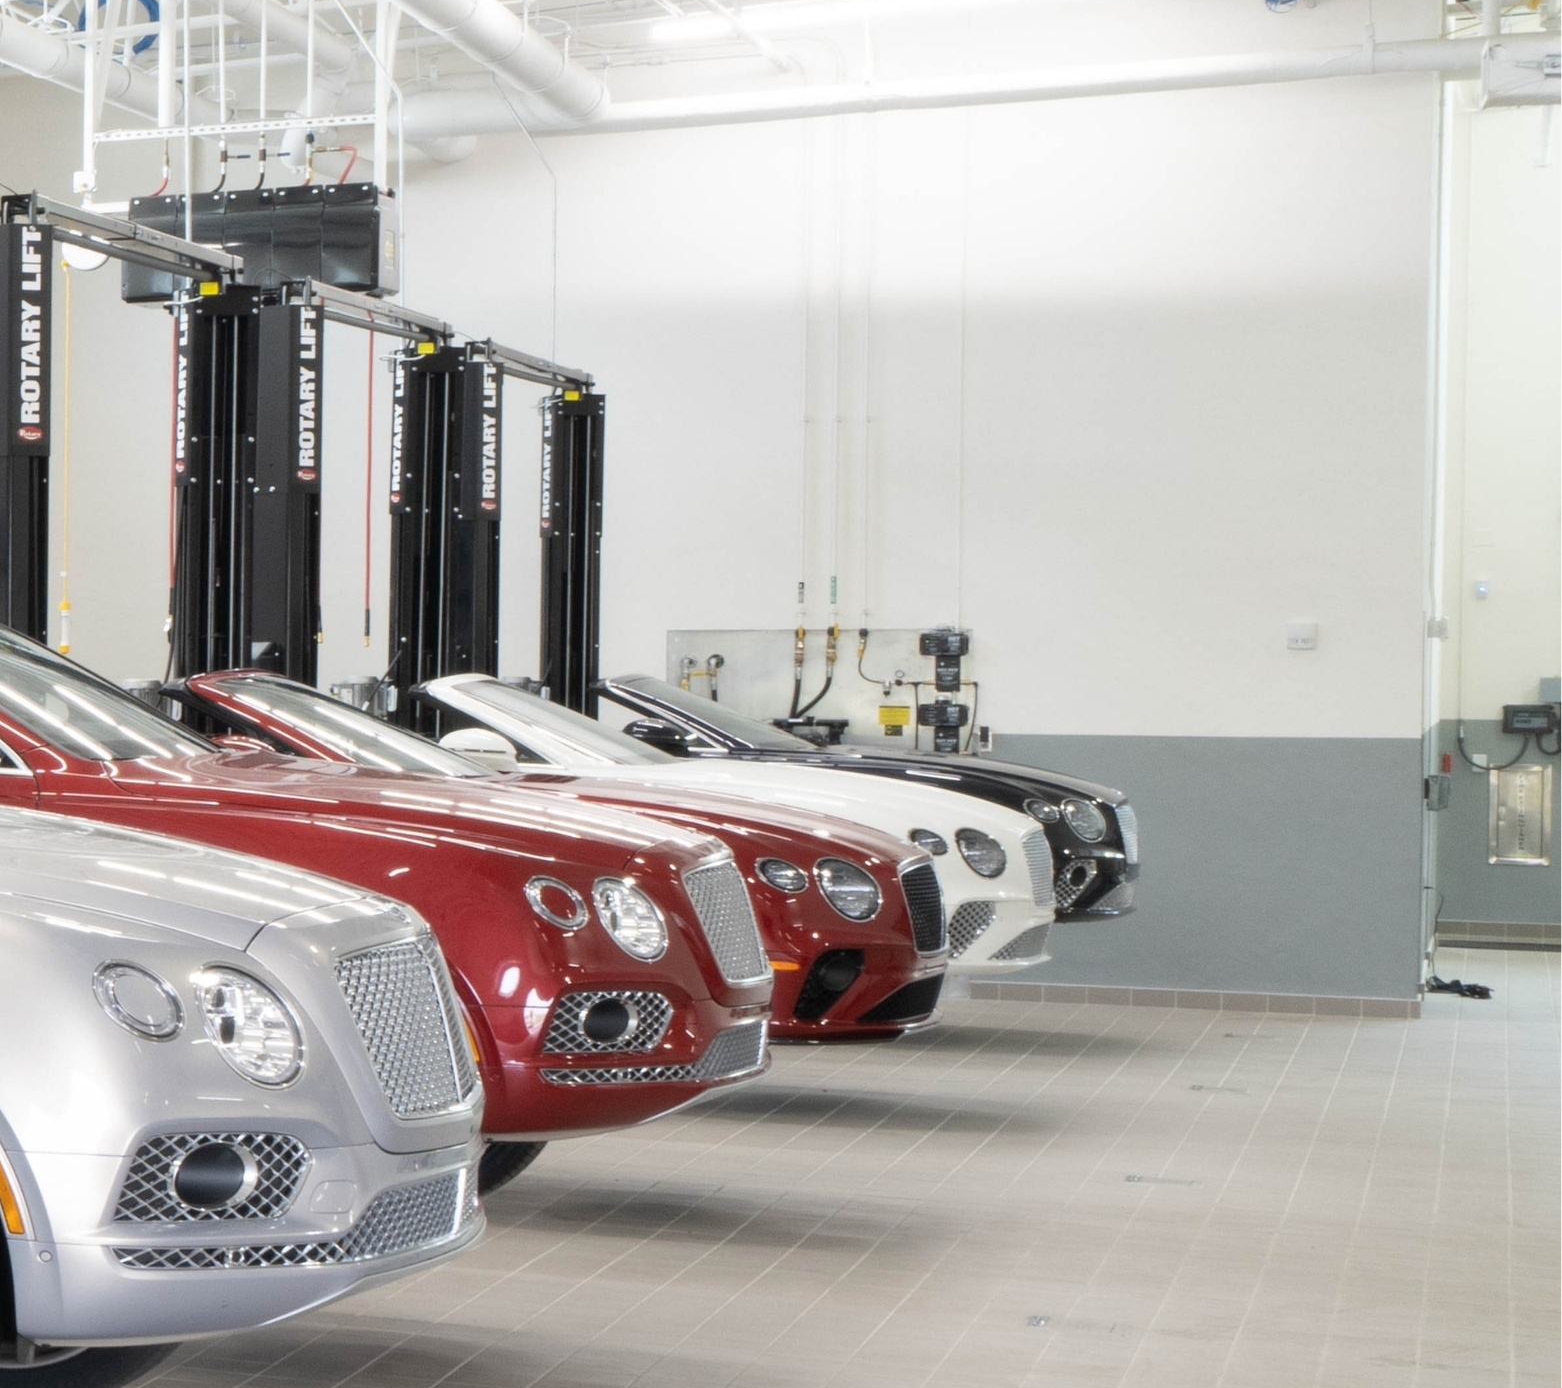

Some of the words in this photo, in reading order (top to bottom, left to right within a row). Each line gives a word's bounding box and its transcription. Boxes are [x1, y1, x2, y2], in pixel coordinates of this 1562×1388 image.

[22, 226, 42, 291] LIFT
[21, 301, 41, 423] ROTARY
[300, 307, 317, 359] LIFT
[395, 352, 405, 398] LIFT
[483, 363, 497, 409] LIFT
[298, 366, 316, 467] ROTARY
[391, 404, 404, 491] ROTARY
[482, 414, 497, 499] ROTARY
